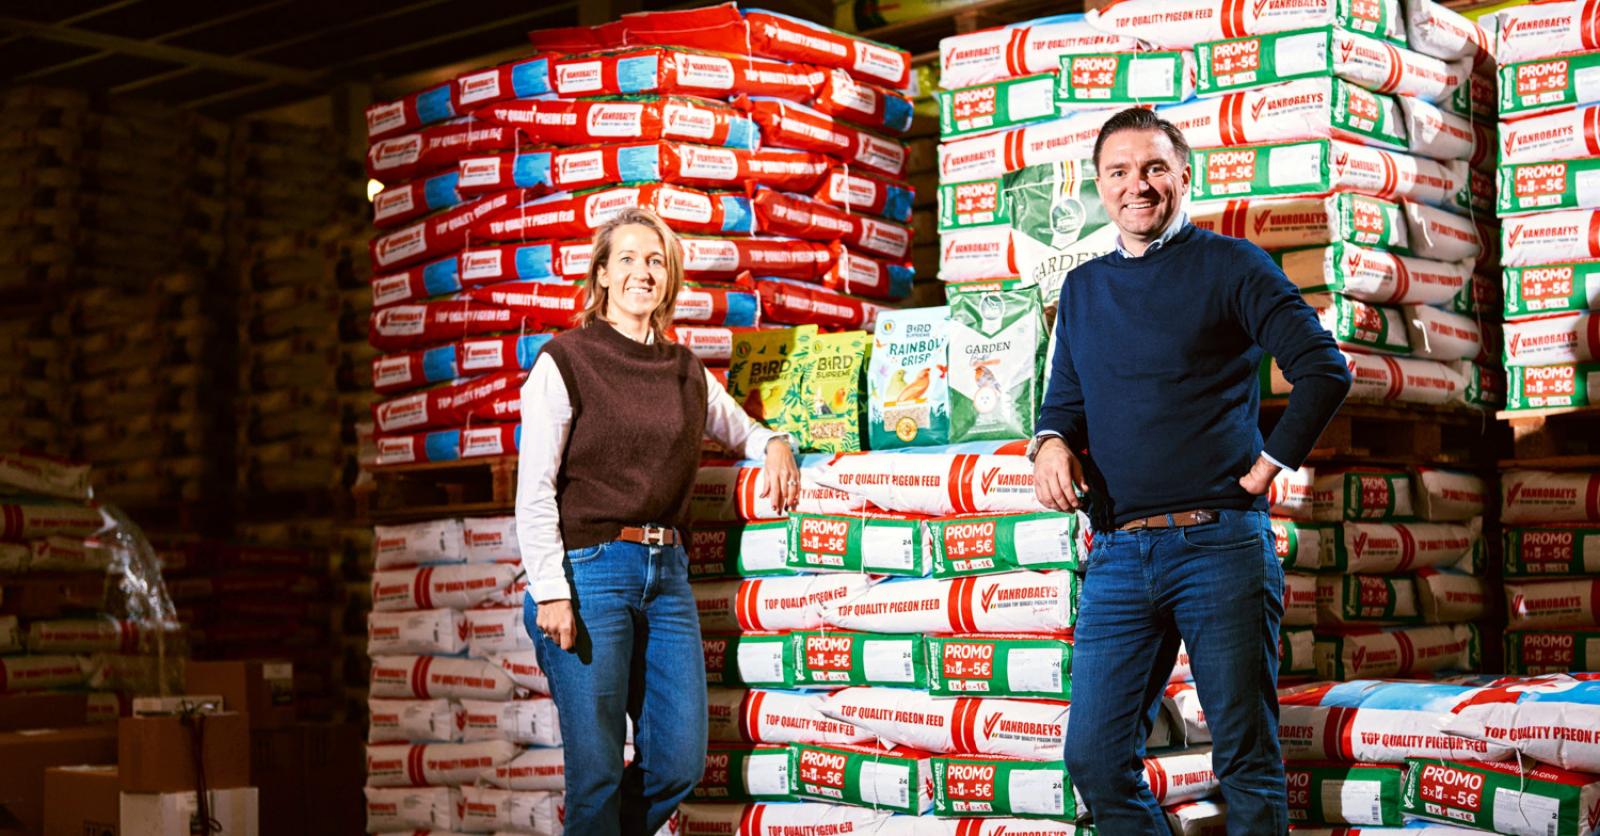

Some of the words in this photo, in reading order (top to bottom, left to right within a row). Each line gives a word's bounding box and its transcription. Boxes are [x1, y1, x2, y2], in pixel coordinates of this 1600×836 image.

[1268, 0, 1328, 10] VANROBAEYS
[1115, 17, 1132, 28] TOP
[1133, 14, 1163, 27] QUALITY
[1166, 11, 1193, 24] PIGEON
[1195, 8, 1213, 21] FEED
[1517, 16, 1571, 31] VANROBAEYS
[1032, 41, 1049, 51] TOP
[1049, 38, 1076, 50] QUALITY
[1078, 35, 1103, 47] PIGEON
[1214, 41, 1258, 58] PROMO
[955, 46, 1001, 61] VANROBAEYS
[1073, 57, 1117, 73] PROMO
[1519, 61, 1566, 77] PROMO
[955, 89, 995, 105] PROMO
[1267, 94, 1323, 110] VANROBAEYS
[1195, 116, 1211, 128] FEED
[1518, 126, 1573, 145] VANROBAEYS
[1031, 142, 1045, 152] TOP
[1047, 137, 1074, 150] QUALITY
[952, 149, 997, 166] VANROBAEYS
[1209, 152, 1254, 167] PROMO
[1517, 165, 1565, 180] PROMO
[957, 184, 997, 199] PROMO
[1270, 213, 1328, 227] VANROBAEYS
[1523, 226, 1579, 239] VANROBAEYS
[955, 242, 1000, 254] VANROBAEYS
[1523, 268, 1571, 283] PROMO
[1522, 331, 1579, 347] VANROBAEYS
[965, 341, 1011, 355] GARDEN
[901, 353, 931, 367] CRISP
[1525, 366, 1573, 380] PROMO
[838, 473, 854, 486] TOP
[856, 473, 890, 487] QUALITY
[892, 474, 920, 488] PIGEON
[921, 474, 940, 488] FEED
[997, 473, 1034, 487] VANROB
[1521, 487, 1577, 499] VANROBAEYS
[802, 520, 848, 536] PROMO
[946, 523, 993, 540] PROMO
[691, 531, 726, 544] ROMO
[1523, 531, 1572, 545] PROMO
[970, 539, 993, 553] -5€
[765, 597, 779, 609] TOP
[809, 591, 834, 605] PIGEON
[997, 586, 1058, 601] VANROBAEYS
[838, 603, 854, 616] TOP
[854, 601, 888, 615] QUALITY
[889, 599, 919, 614] PIGEON
[920, 598, 940, 611] FEED
[1525, 597, 1581, 610] VANROBAEYS
[806, 637, 851, 651] PROMO
[1524, 634, 1573, 649] PROMO
[945, 644, 992, 660] PROMO
[944, 663, 955, 674] 3x
[968, 662, 991, 676] -5€
[766, 713, 780, 726] TOP
[780, 715, 810, 730] QUALITY
[841, 705, 858, 719] TOP
[859, 706, 895, 721] QUALITY
[896, 709, 924, 724] PIGEON
[926, 714, 944, 728] FEED
[999, 720, 1061, 737] VANROBAEYS
[1279, 726, 1314, 739] OBAEYS
[1484, 726, 1508, 740] TOP
[1509, 726, 1551, 742] QUALITY
[1553, 726, 1591, 744] PIGEON
[1361, 731, 1381, 746] TOP
[1382, 733, 1425, 750] QUALITY
[1427, 735, 1464, 752] PIGEON
[801, 750, 846, 770] PROMO
[822, 771, 843, 785] -5€
[947, 764, 994, 781] PROMO
[1173, 774, 1184, 787] TOP
[1185, 771, 1210, 785] QUALITY
[1422, 764, 1482, 792] PROMO
[948, 784, 959, 795] 3x
[970, 782, 992, 798] -5€
[1288, 789, 1307, 804] 5€
[1422, 786, 1435, 799] 3x
[1450, 790, 1478, 809] -5€
[1427, 804, 1440, 816] 1x
[768, 824, 784, 836] TOP
[784, 822, 816, 836] QUALITY
